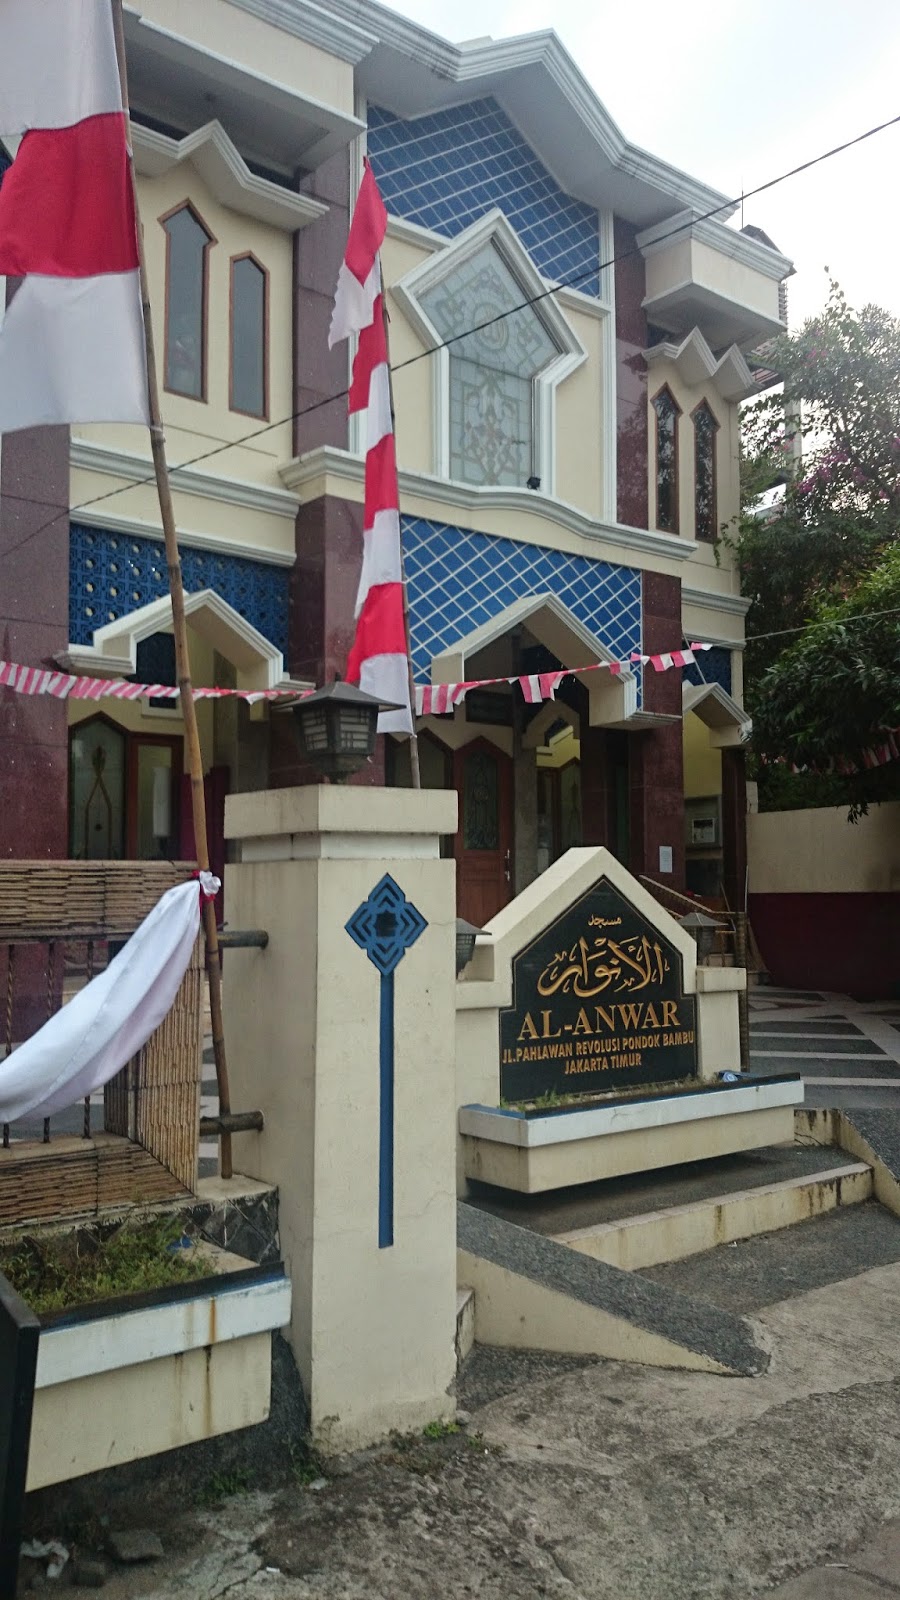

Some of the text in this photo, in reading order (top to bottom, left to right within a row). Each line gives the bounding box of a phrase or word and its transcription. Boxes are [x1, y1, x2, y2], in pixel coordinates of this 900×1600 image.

[588, 914, 622, 929] مسجد
[517, 1001, 681, 1041] AL-ANWAR
[575, 1036, 620, 1055] REVOLUSI
[622, 1033, 660, 1050] PONDOK
[662, 1031, 694, 1046] BAMBU
[564, 1053, 642, 1075] JAKARTA TIMUR
